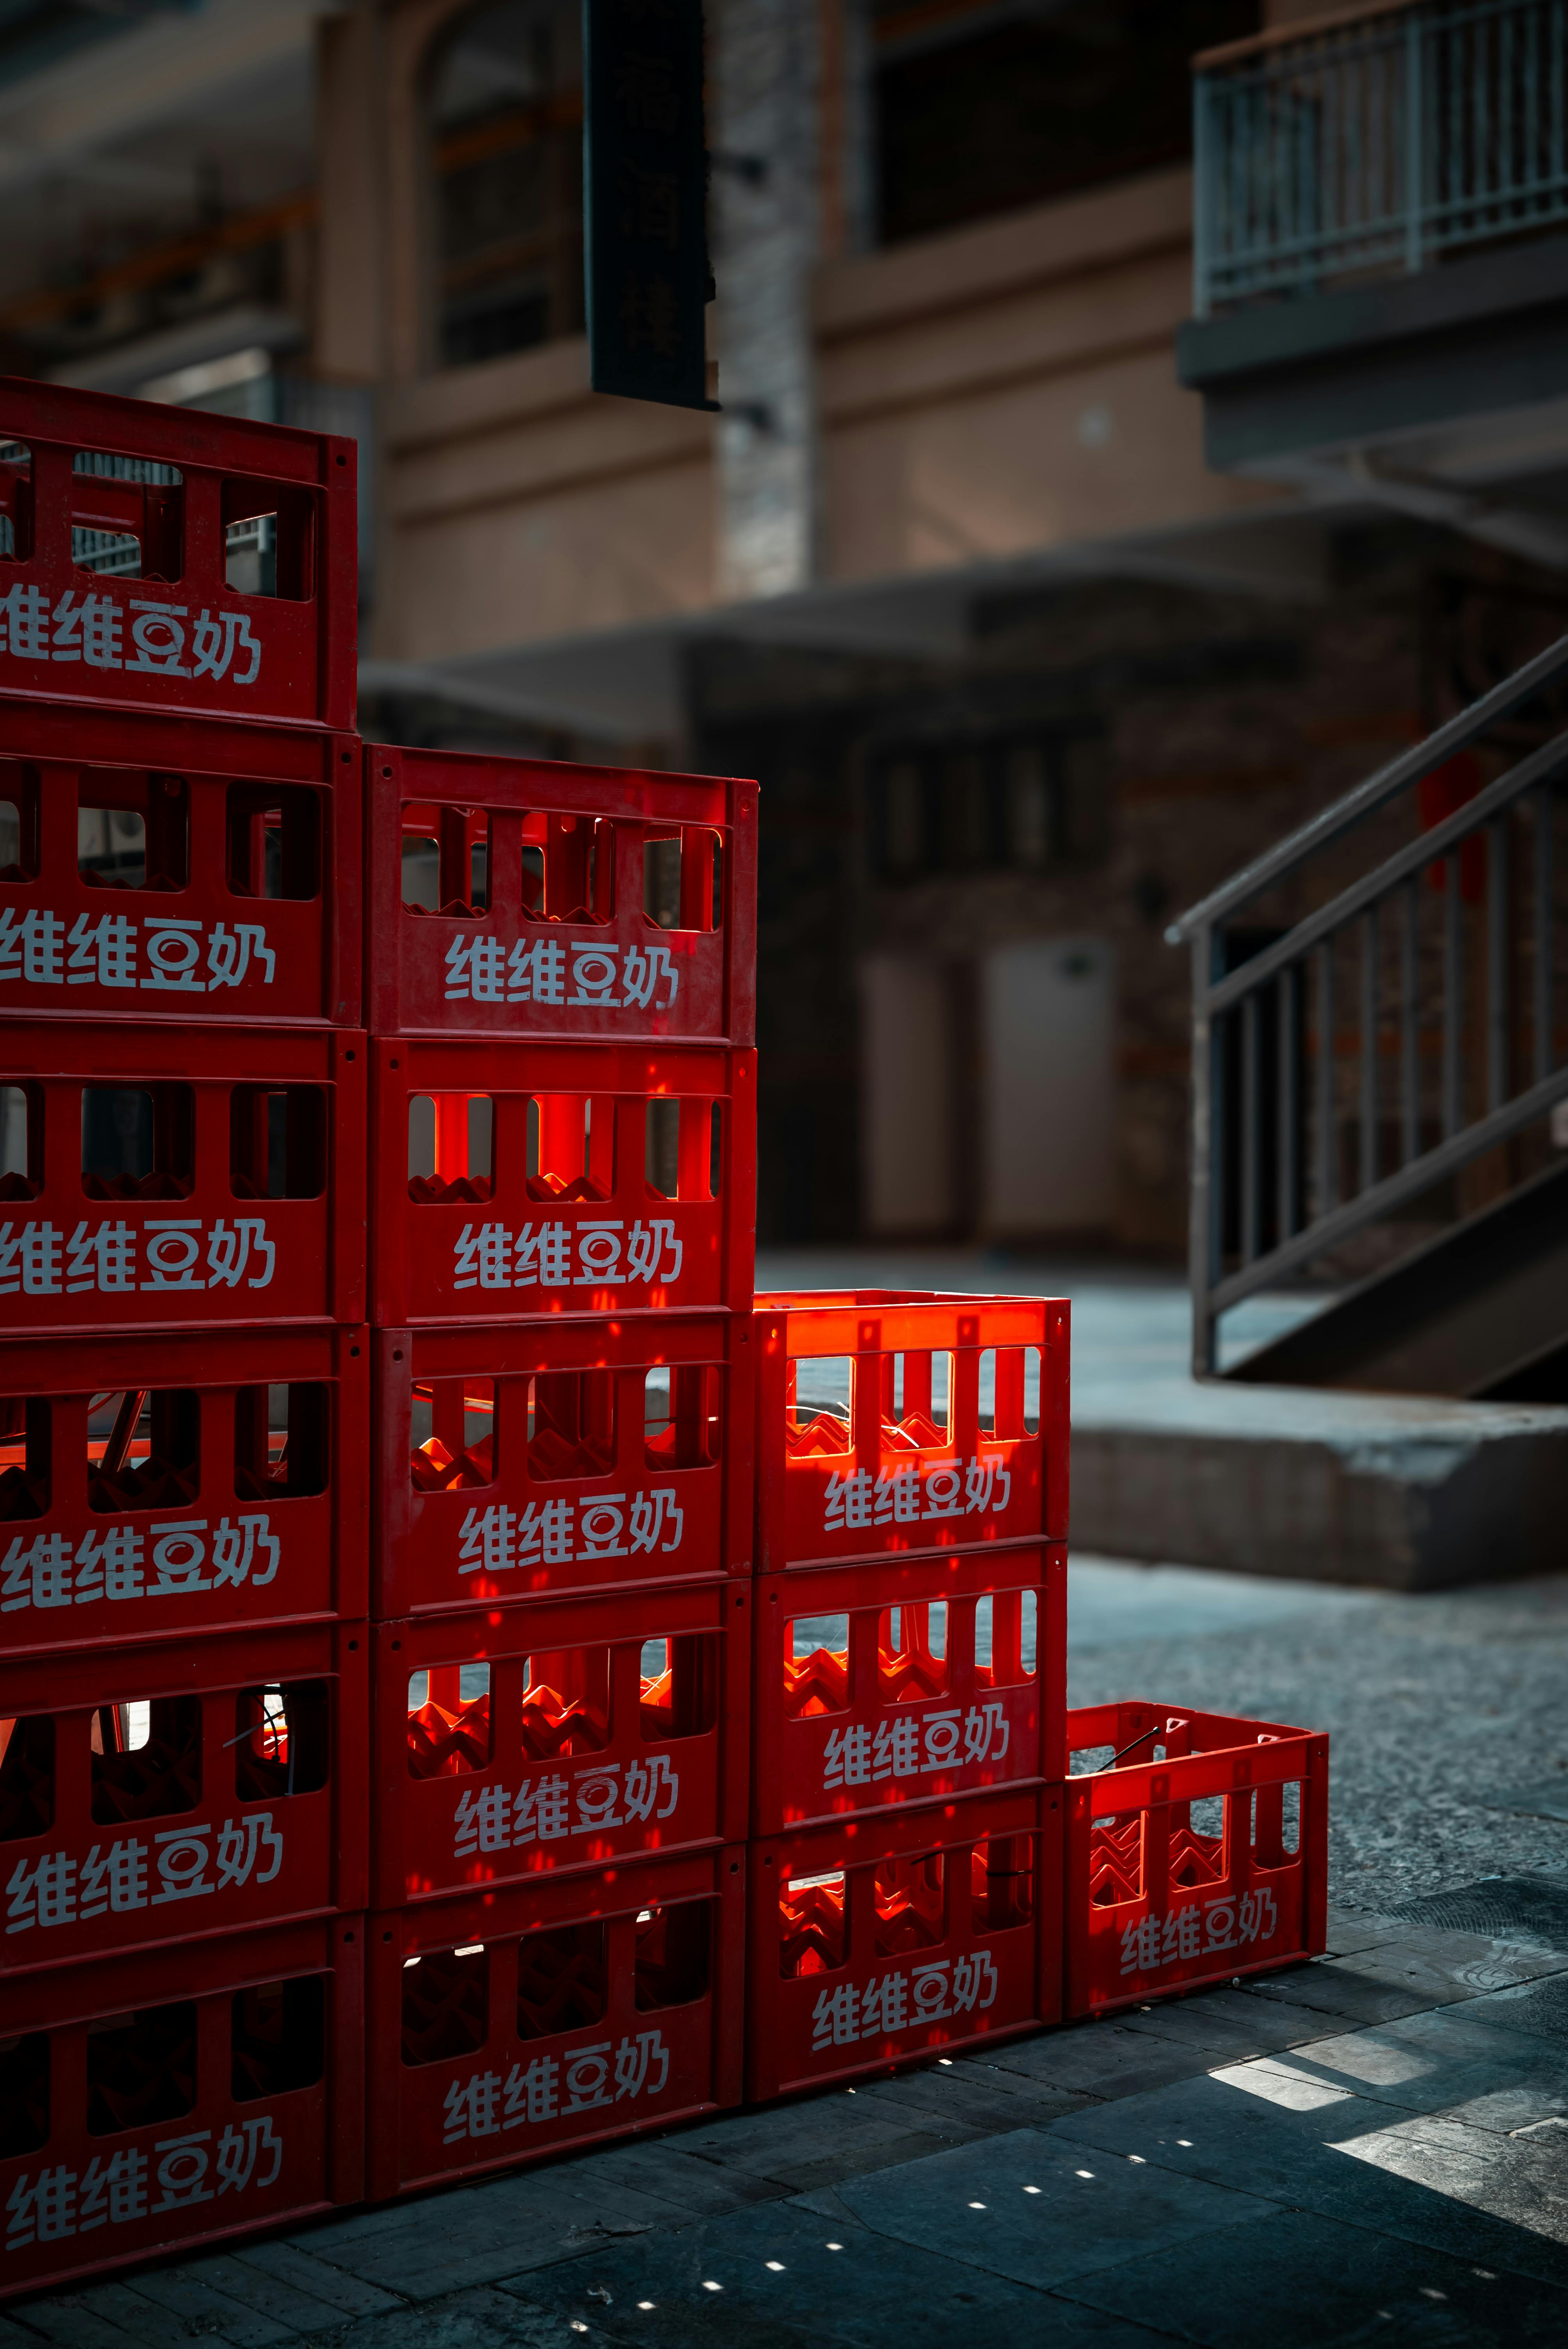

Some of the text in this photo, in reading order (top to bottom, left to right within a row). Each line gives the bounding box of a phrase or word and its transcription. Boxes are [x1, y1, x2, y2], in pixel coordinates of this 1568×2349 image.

[611, 0, 683, 359] 福酒樓
[0, 583, 262, 685] 维维豆奶
[0, 907, 276, 992] 维维豆奶
[444, 934, 678, 1010] 维维豆奶
[0, 1218, 276, 1295] 维维豆奶
[453, 1219, 683, 1290] 维维豆奶
[458, 1488, 684, 1576] 维维豆奶
[823, 1454, 1011, 1531] 维维豆奶
[0, 1513, 281, 1613] 维维豆奶
[823, 1703, 1010, 1790] 维维豆奶
[453, 1754, 679, 1858] 维维豆奶
[5, 1812, 284, 1934] 维维豆奶
[1120, 1887, 1278, 1977] 维维豆奶
[811, 1950, 998, 2051] 维维豆奶
[442, 2029, 670, 2146] 维维豆奶
[5, 2115, 283, 2252] 维维豆奶
